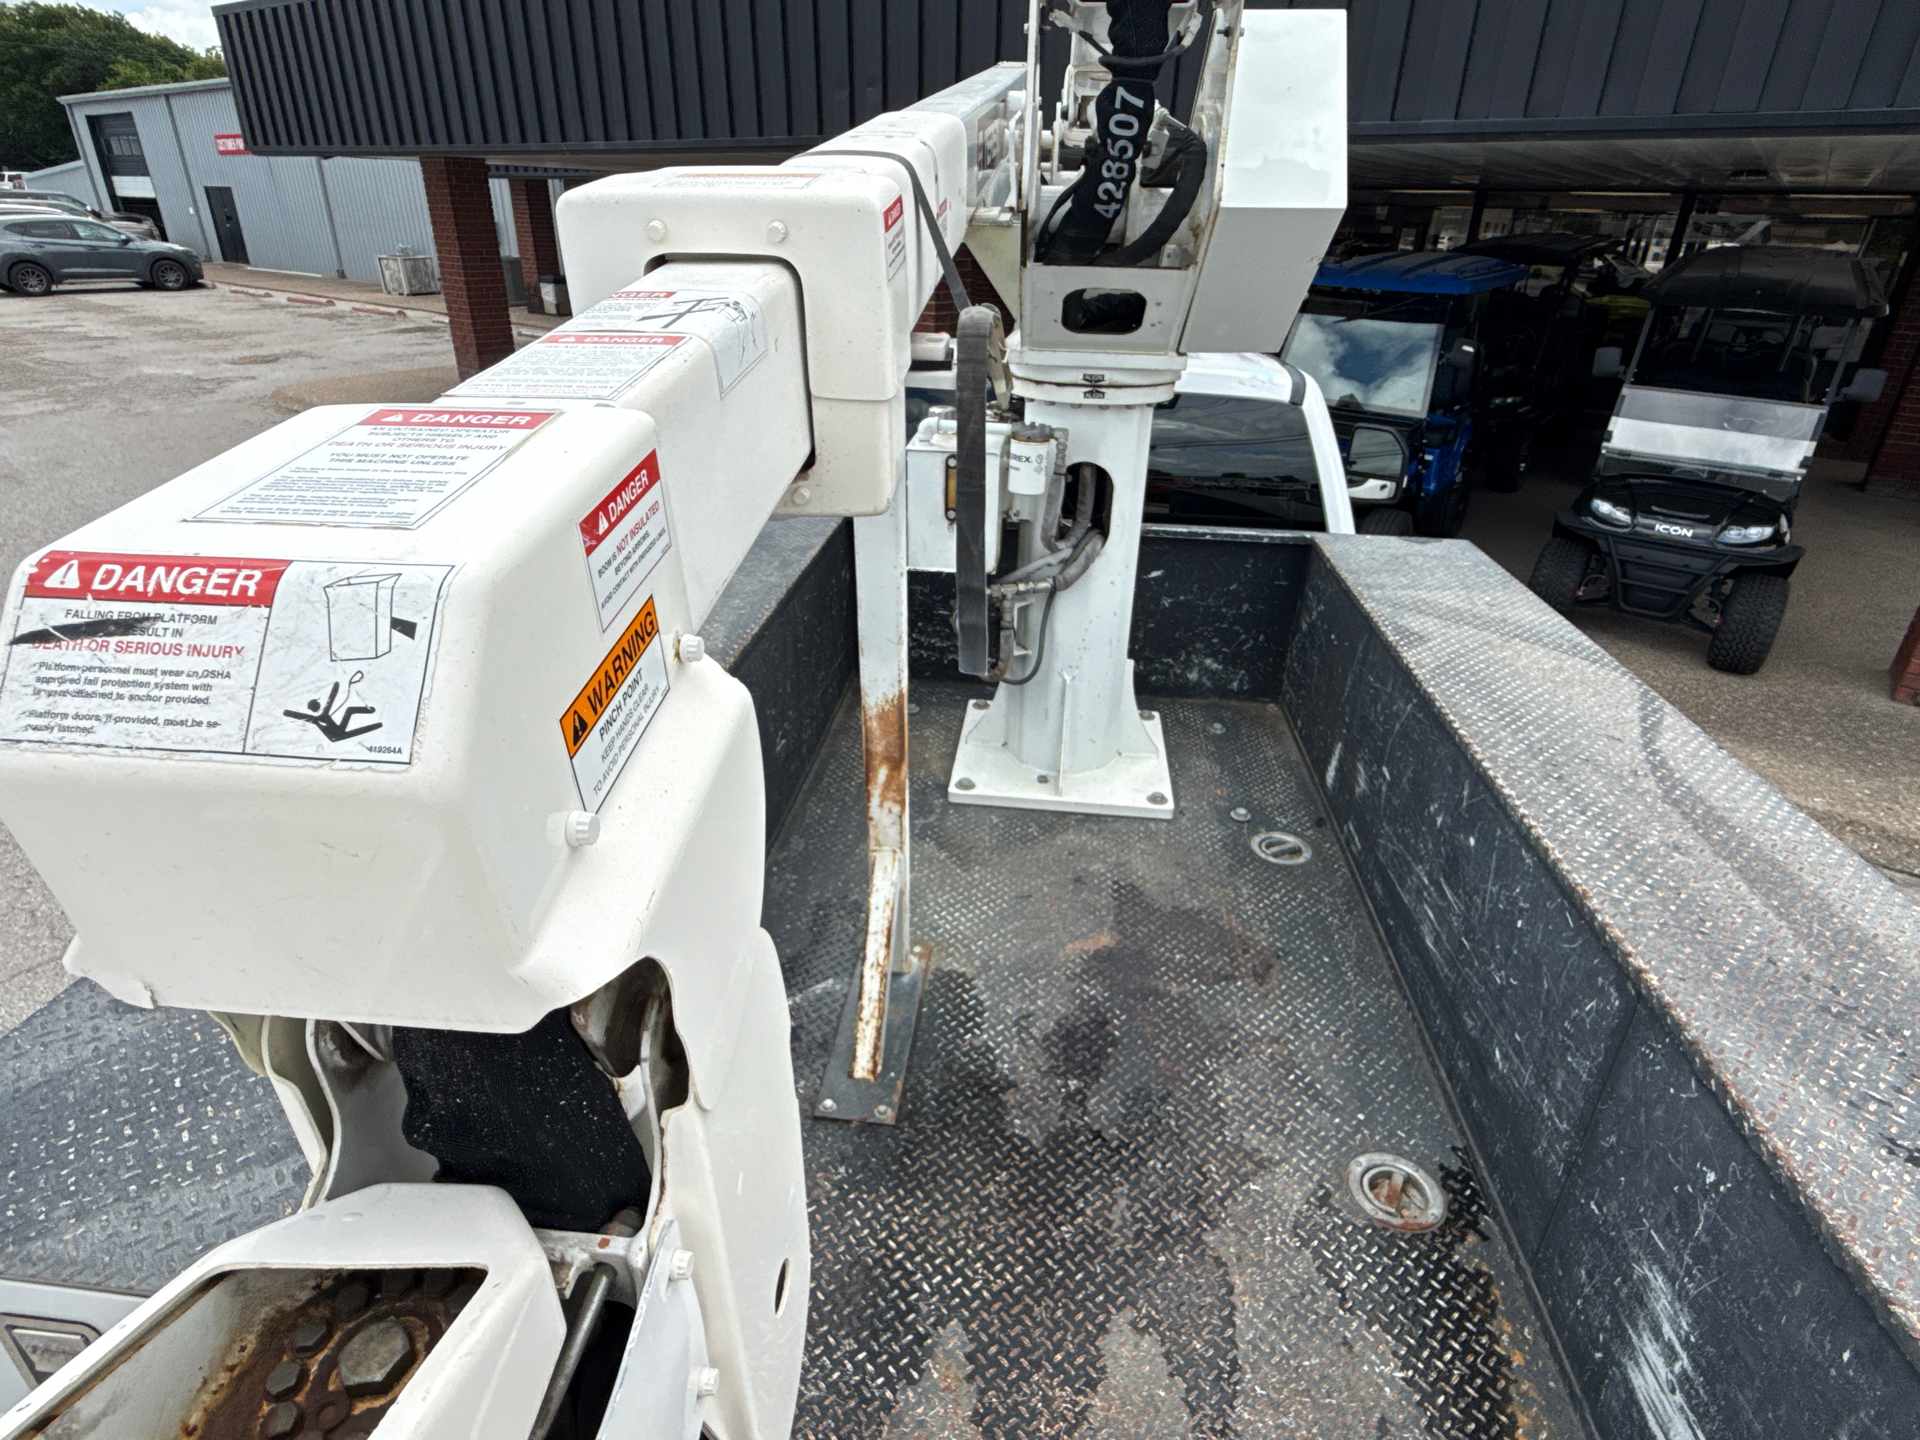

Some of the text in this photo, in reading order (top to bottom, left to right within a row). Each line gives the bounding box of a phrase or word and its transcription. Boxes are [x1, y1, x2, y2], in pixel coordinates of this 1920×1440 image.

[1094, 86, 1145, 219] 428507
[410, 413, 532, 426] DANGER
[608, 469, 649, 523] DANGER
[597, 500, 660, 578] BOOM IS NOT INSULATED
[1655, 523, 1693, 538] ICON
[614, 551, 632, 575] BEYOND
[91, 564, 262, 597] DANGER
[600, 590, 613, 610] AVOID
[612, 571, 630, 595] CONTACT
[629, 560, 639, 574] WITH
[65, 609, 218, 625] FALLING FROM PLATFORM
[127, 626, 184, 638] ESULT IN
[87, 639, 110, 652] OR
[114, 640, 183, 656] SERIOUS
[187, 643, 245, 659] INJURY
[39, 661, 77, 672] Platform
[81, 664, 131, 674] personnel
[133, 667, 158, 676] must
[160, 669, 185, 678] wear
[200, 669, 231, 679] OSHA
[587, 609, 656, 716] WARNING
[35, 676, 213, 692] approved fall protection system with
[115, 692, 125, 700] to
[128, 693, 163, 703] anchor
[165, 695, 211, 705] provided.
[599, 667, 643, 742] PINCH POINT
[28, 710, 69, 720] Platform
[72, 712, 102, 723] doors,
[114, 715, 160, 726] provided,
[163, 717, 189, 727] must
[191, 718, 204, 728] be
[206, 720, 221, 728] se-
[601, 683, 649, 763] KEEP HANDS CLEAR
[369, 745, 403, 755] 419264A
[593, 780, 602, 796] TO
[602, 752, 619, 784] AVOID
[618, 714, 644, 756] PERSONAL
